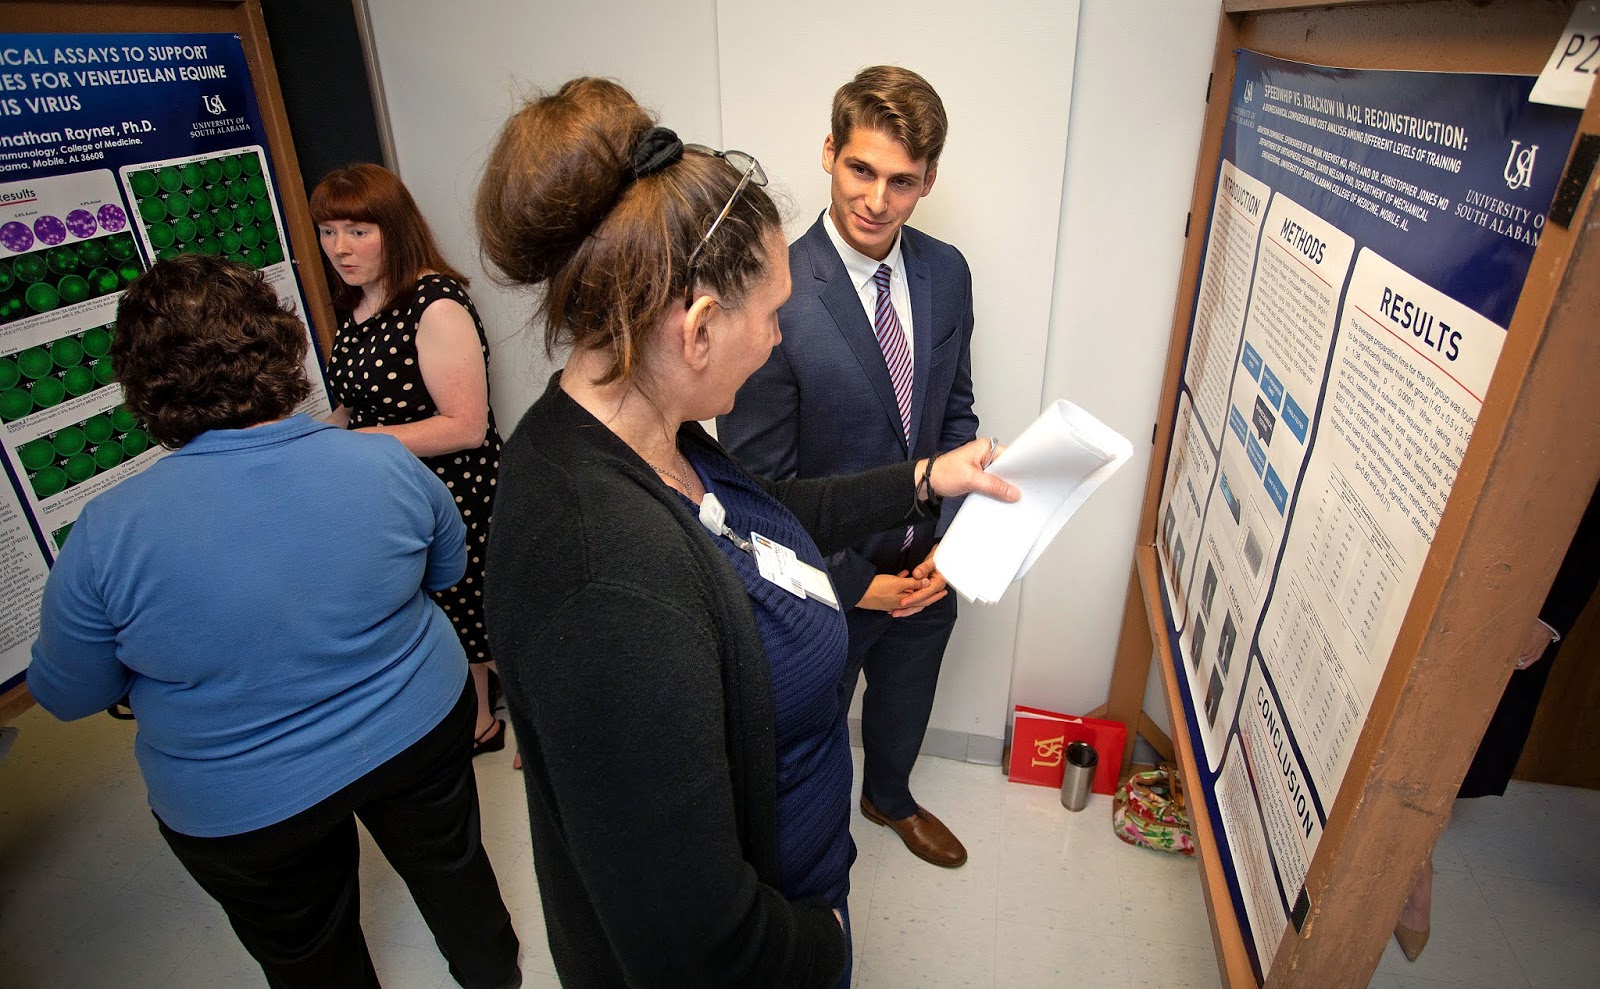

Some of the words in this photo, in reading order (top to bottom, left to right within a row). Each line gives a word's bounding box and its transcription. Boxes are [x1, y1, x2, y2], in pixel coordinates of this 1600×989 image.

[31, 72, 72, 89] FOR
[74, 68, 176, 86] VENEZUELAN
[178, 65, 227, 81] EQUINE
[54, 47, 120, 64] ASSAYS
[122, 46, 144, 62] TO
[148, 46, 208, 60] SUPPORT
[1556, 34, 1600, 74] P2
[0, 98, 22, 116] IS
[25, 95, 81, 114] VIRUS
[192, 118, 234, 130] UNIVERSITY
[236, 116, 244, 124] OF
[1264, 84, 1292, 104] SPEEDWHIP
[1294, 92, 1302, 107] VS.
[1304, 94, 1335, 116] KRACKOW
[1336, 102, 1344, 118] IN
[1346, 104, 1362, 124] ACL
[1364, 108, 1468, 151] RECONSTRUCTION:
[0, 131, 62, 147] nathan
[65, 125, 120, 141] Rayner,
[122, 120, 157, 135] Ph.D.
[60, 144, 93, 154] College
[94, 141, 103, 150] of
[190, 128, 214, 138] SOUTH
[217, 124, 250, 134] ALABAMA
[1317, 118, 1327, 130] COST
[1327, 121, 1347, 137] ANALYSIS
[1347, 128, 1364, 142] AMONG
[1364, 132, 1394, 152] DIFFERENT
[1393, 141, 1416, 160] LEVELS
[1416, 148, 1426, 162] OF
[1426, 152, 1462, 174] TRAINING
[69, 155, 80, 164] AL
[80, 152, 104, 162] 36608
[1504, 140, 1539, 190] USA
[1222, 173, 1262, 217] INTRODUCTION
[1302, 170, 1316, 181] SOUTH
[1314, 176, 1332, 191] ALABAMA
[1332, 182, 1351, 200] COLLEGE
[1350, 192, 1357, 203] OF
[1356, 196, 1379, 217] MEDICINE,
[1379, 208, 1400, 228] MOBILE,
[1400, 218, 1408, 231] AL.
[1328, 167, 1345, 182] NELSON
[1344, 174, 1354, 188] PHD,
[1354, 179, 1386, 201] DEPARTMENT
[1386, 193, 1394, 204] OF
[1393, 196, 1428, 222] MECHANICAL
[1360, 164, 1371, 179] AND
[1371, 170, 1380, 182] DR.
[1380, 174, 1418, 198] CHRISTOPHER
[1417, 188, 1438, 206] JONES
[1437, 196, 1449, 210] MD
[1466, 190, 1530, 224] UNIVERSITY
[1455, 203, 1488, 227] SOUTH
[1280, 217, 1326, 264] METHODS
[1380, 286, 1463, 362] RESULTS
[1358, 325, 1373, 341] average
[1373, 338, 1398, 361] preparation
[1398, 355, 1408, 369] time
[1408, 363, 1416, 375] for
[1416, 370, 1425, 382] the
[1425, 376, 1436, 389] SW
[1433, 386, 1449, 403] group
[1449, 400, 1460, 413] was
[1358, 340, 1380, 364] significantly
[1381, 358, 1394, 373] faster
[1394, 369, 1405, 383] than
[1404, 377, 1414, 390] MK
[1413, 387, 1428, 403] group
[1427, 398, 1441, 415] (1.43
[1444, 414, 1454, 427] 0.5
[1342, 357, 1368, 382] consideration
[1368, 378, 1377, 390] that
[1380, 391, 1397, 409] sutures
[1397, 406, 1405, 417] are
[1405, 414, 1423, 436] required
[1422, 431, 1428, 442] to
[1428, 437, 1439, 454] fully
[1355, 381, 1374, 406] hamstring
[1387, 413, 1395, 425] the
[1395, 423, 1405, 436] cost
[1405, 434, 1422, 455] savings
[1431, 462, 1442, 476] one
[1419, 407, 1432, 425] When
[1435, 425, 1450, 447] taking
[1356, 400, 1378, 424] preparation
[1380, 424, 1392, 441] using
[1403, 447, 1412, 460] SW
[1413, 460, 1436, 489] technique
[1370, 429, 1390, 455] Difference
[1394, 457, 1416, 485] elongation
[1415, 482, 1427, 497] after
[1344, 418, 1352, 428] and
[1364, 438, 1376, 456] failure
[1376, 451, 1392, 475] between
[1391, 473, 1407, 496] groups,
[1408, 493, 1428, 521] methods,
[1388, 488, 1410, 516] significant
[1256, 686, 1314, 840] CONCLUSION
